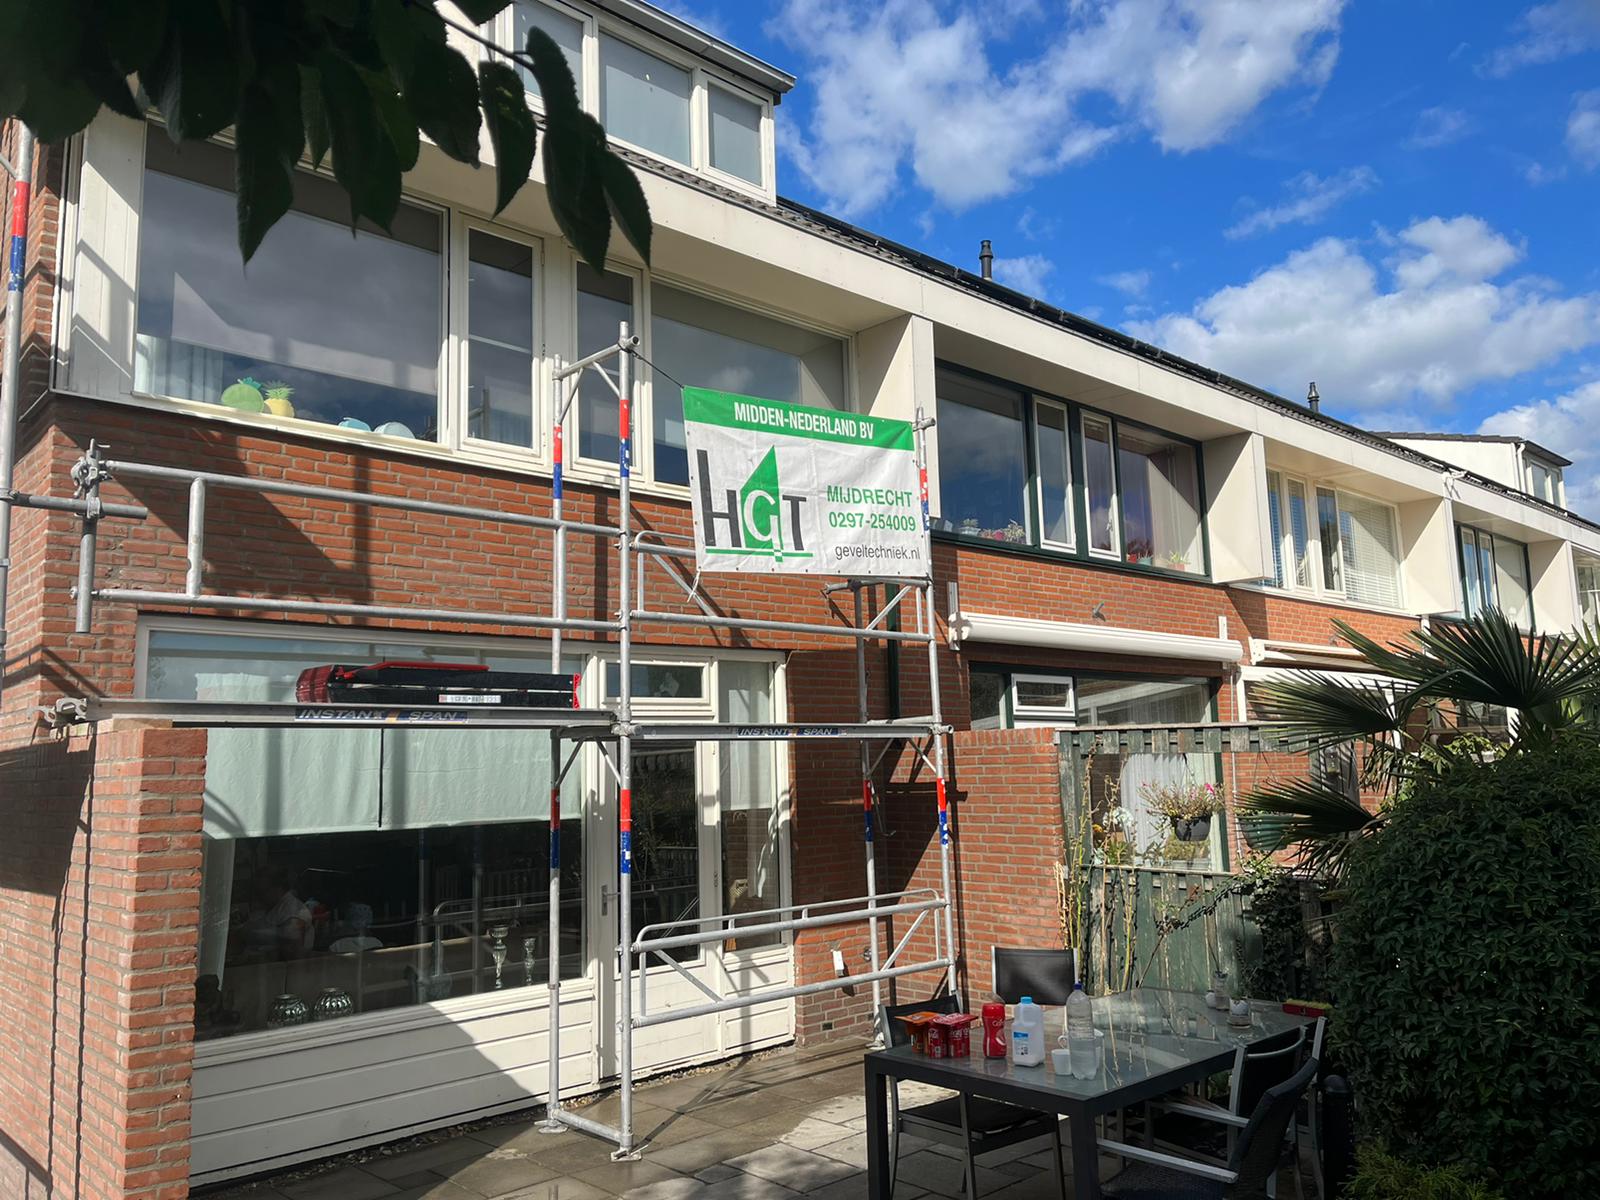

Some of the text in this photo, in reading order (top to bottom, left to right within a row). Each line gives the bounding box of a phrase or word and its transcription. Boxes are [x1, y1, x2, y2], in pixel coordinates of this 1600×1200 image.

[734, 402, 874, 440] MIDDEN-NEDERLAND BV
[827, 485, 912, 508] MIJDRECHT
[829, 511, 916, 532] 0297-254009
[835, 544, 921, 561] geveltechniek.nl
[408, 711, 457, 721] SPAN
[803, 728, 832, 736] SPAN
